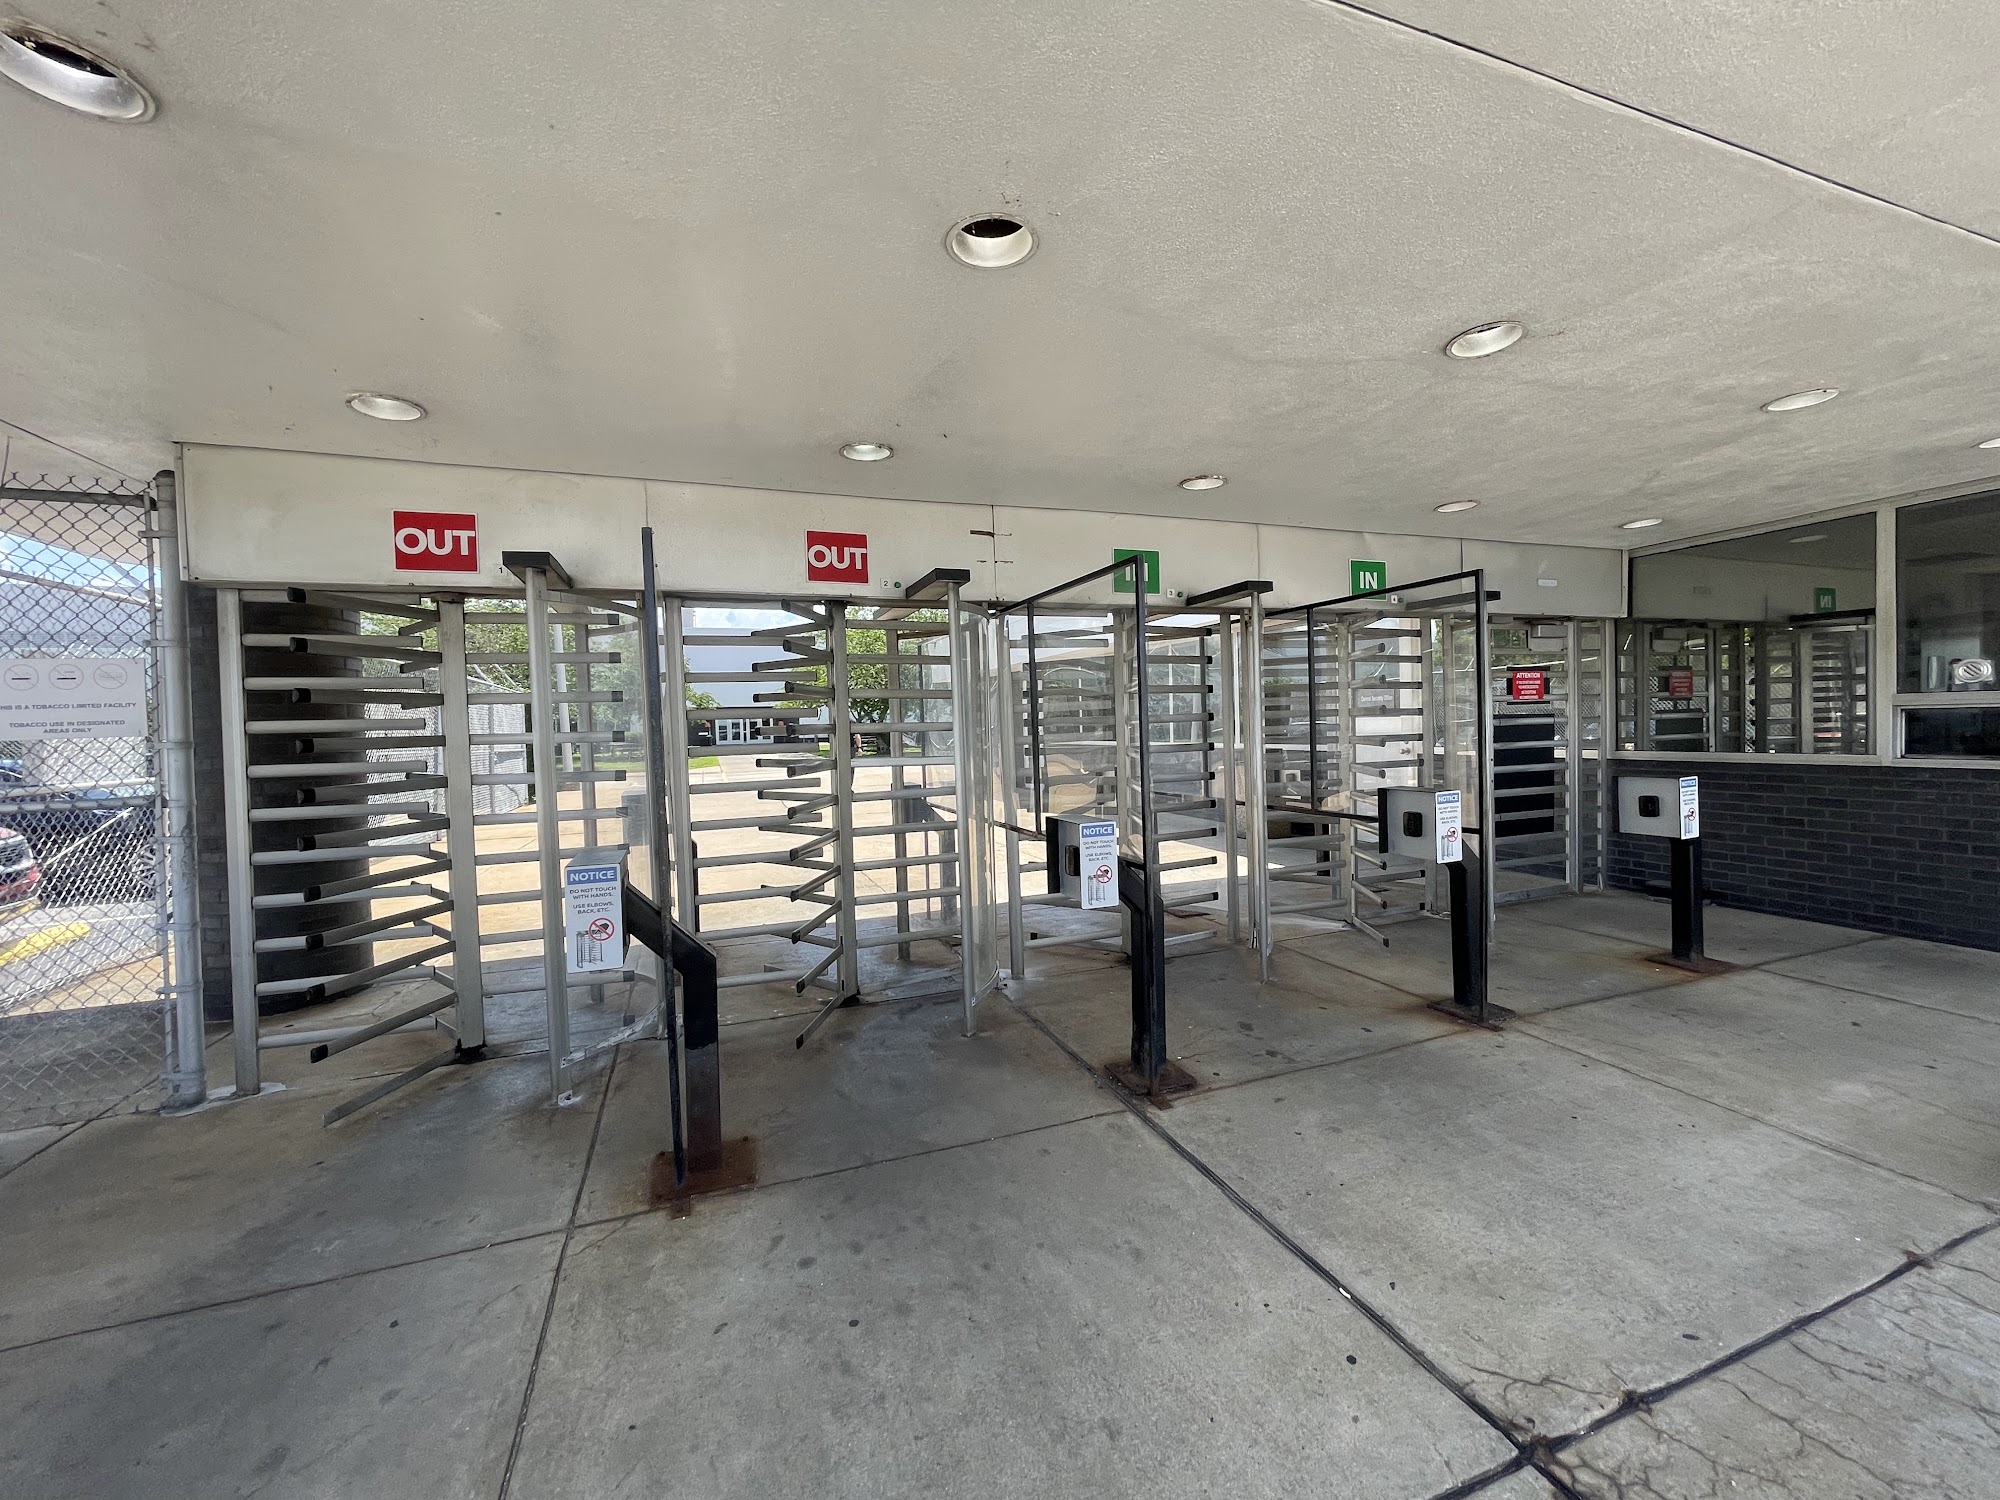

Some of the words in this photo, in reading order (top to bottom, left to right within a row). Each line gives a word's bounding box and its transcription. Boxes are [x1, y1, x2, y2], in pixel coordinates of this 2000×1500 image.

[395, 527, 476, 556] OUT
[808, 544, 867, 570] OUT
[1359, 571, 1378, 590] IN
[1438, 794, 1459, 803] NOTICE
[1083, 826, 1113, 836] NOTICE
[569, 870, 615, 882] NOTICE
